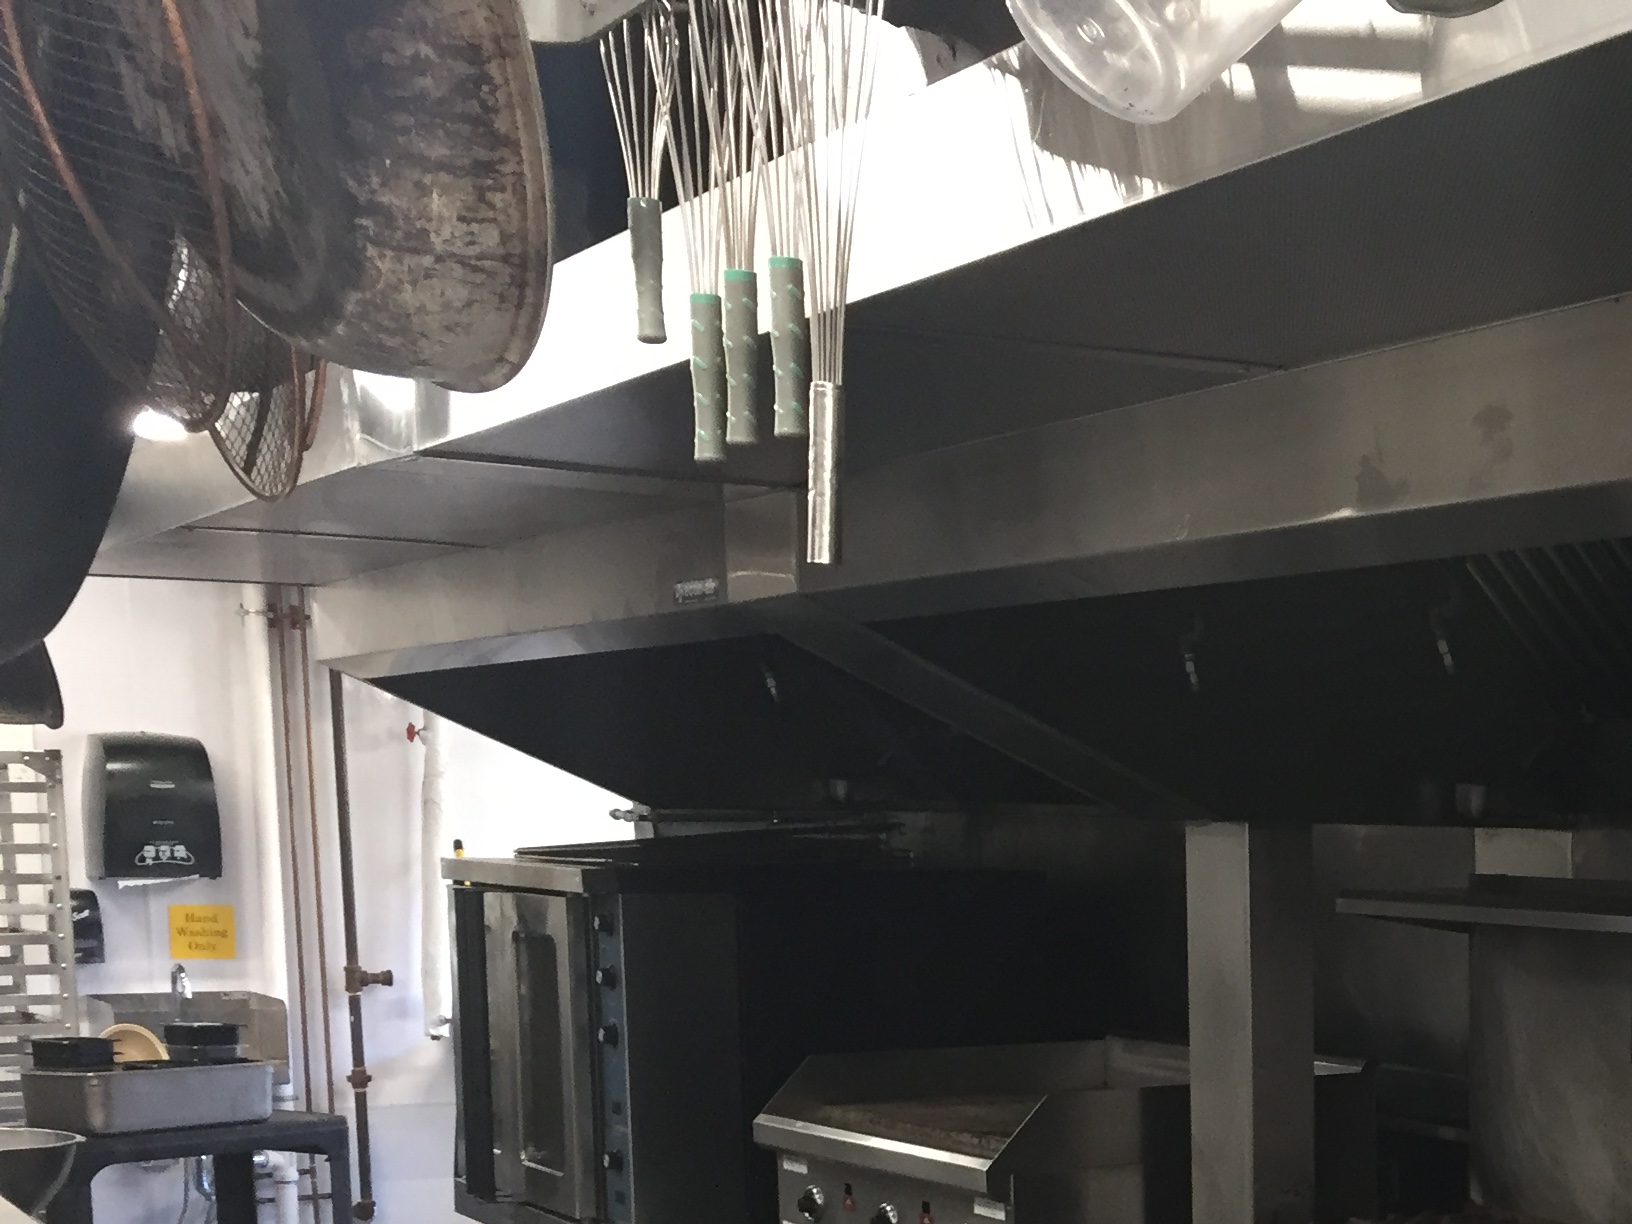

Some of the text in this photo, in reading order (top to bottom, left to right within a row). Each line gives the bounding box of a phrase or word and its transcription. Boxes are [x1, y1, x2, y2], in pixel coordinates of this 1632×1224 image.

[185, 913, 218, 923] Hand
[176, 926, 228, 938] Washing
[188, 941, 217, 951] Only
